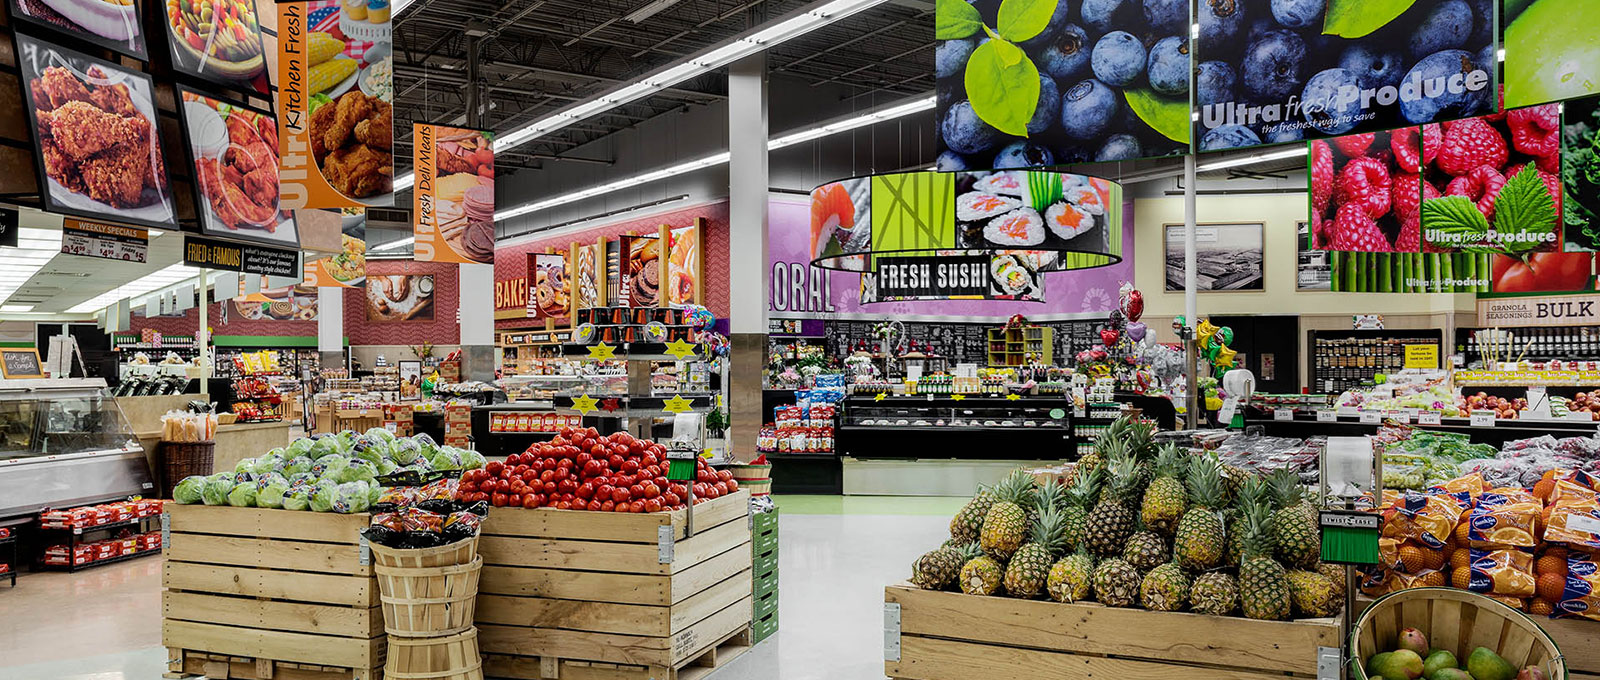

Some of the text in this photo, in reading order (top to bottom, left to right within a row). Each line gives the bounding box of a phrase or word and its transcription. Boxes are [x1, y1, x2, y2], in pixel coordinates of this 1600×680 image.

[284, 5, 302, 130] Kitchen Fresh
[1202, 69, 1488, 129] Ultra fresh Produce
[1261, 112, 1376, 134] the freshest way to save
[419, 126, 431, 227] Fresh Deli Meats
[79, 221, 106, 233] WEEKLY
[107, 226, 137, 238] SPECIALS
[1425, 229, 1461, 242] Ultra
[1486, 228, 1557, 242] Produce
[187, 243, 240, 267] FRIED & FAMOUS
[769, 261, 835, 312] ORAL
[880, 263, 987, 289] FRESH SUSHI
[1444, 277, 1489, 286] Produce
[526, 286, 537, 318] Ultra
[619, 274, 630, 307] Ultra
[1491, 304, 1527, 312] GRANOLA
[1536, 301, 1594, 318] BULK
